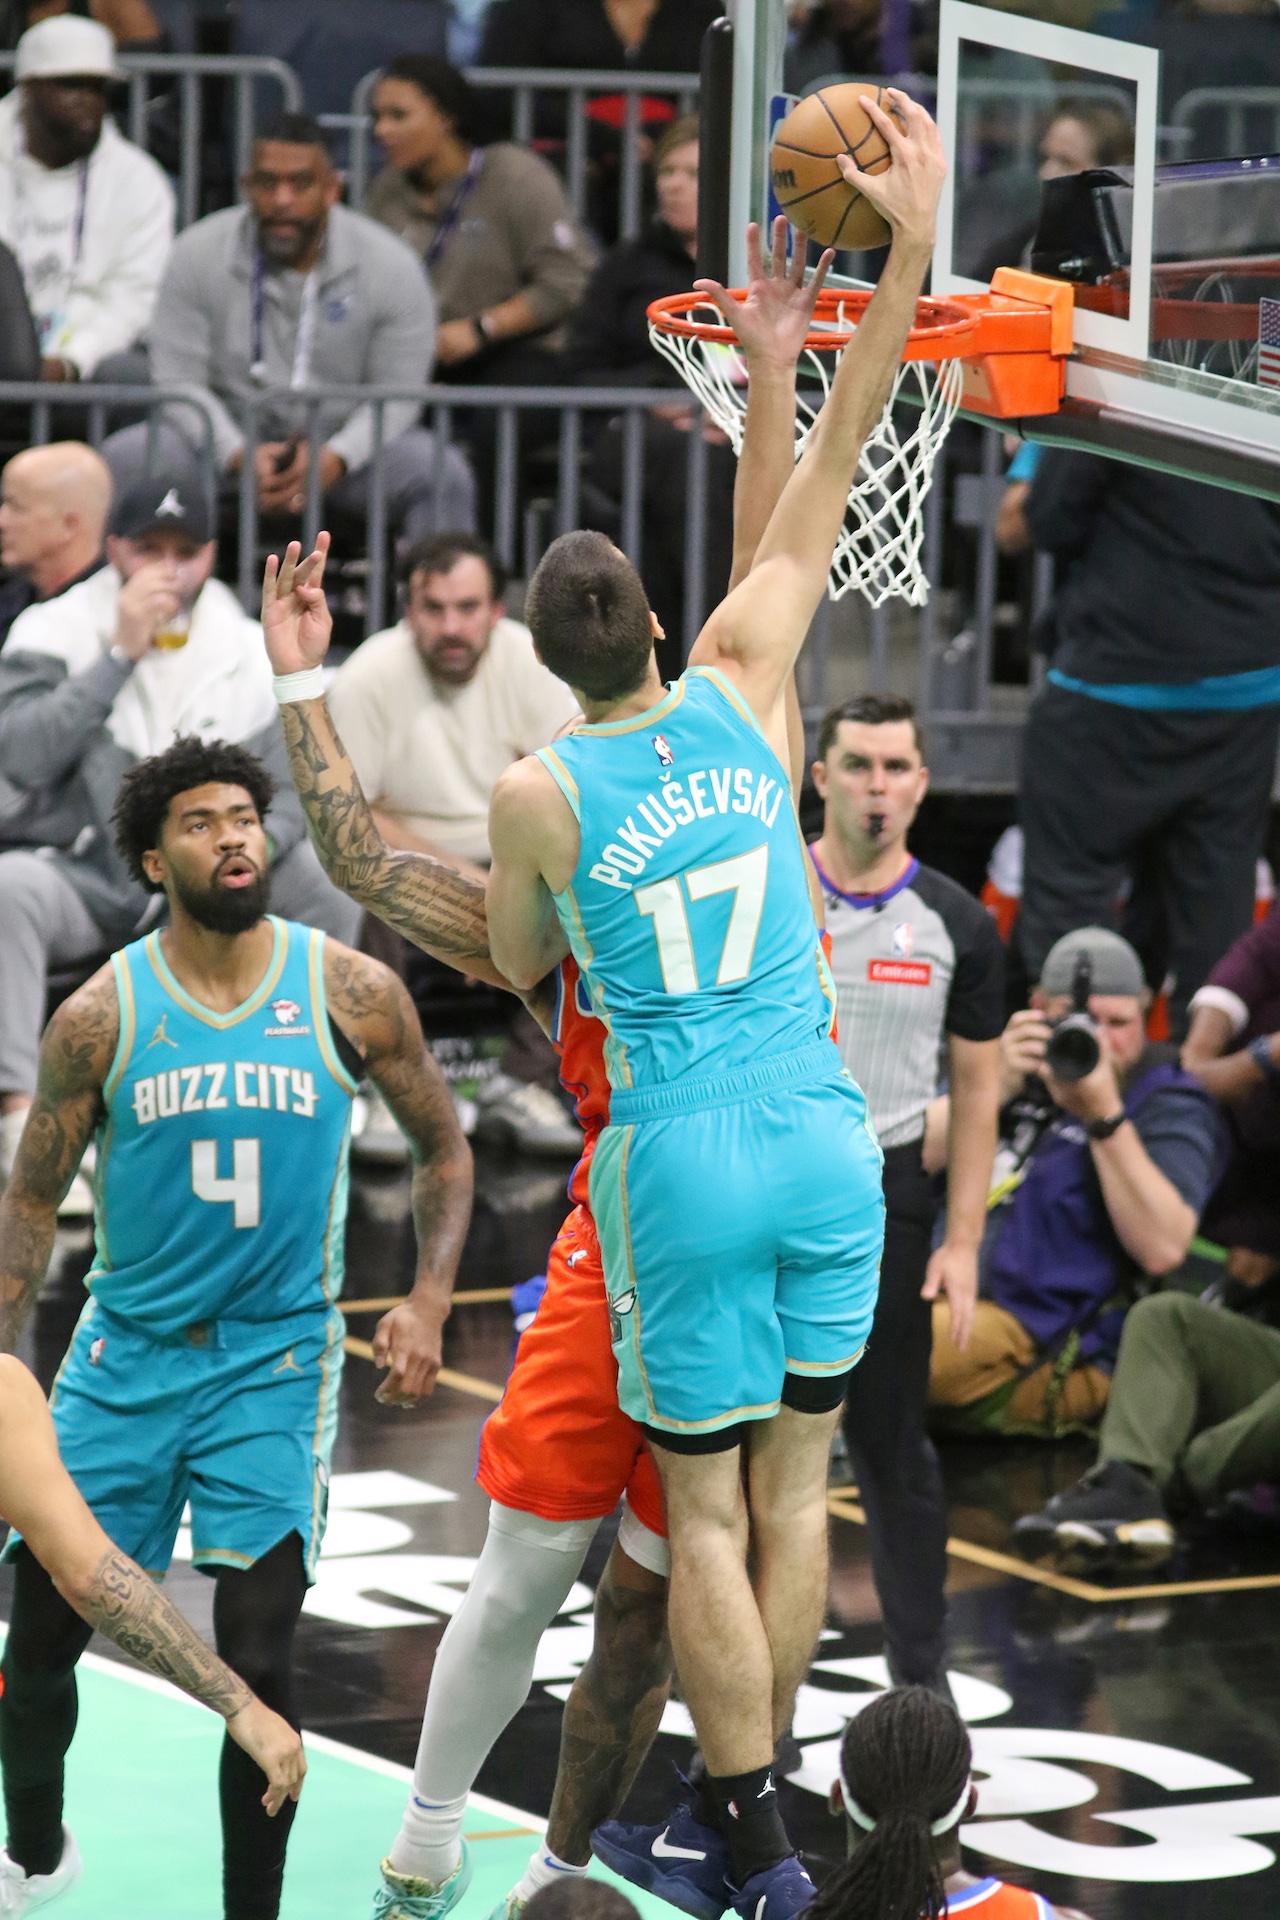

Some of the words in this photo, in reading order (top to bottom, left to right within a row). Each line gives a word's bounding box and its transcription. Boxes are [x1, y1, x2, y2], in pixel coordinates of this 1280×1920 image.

[588, 768, 783, 890] POKUŠEVSKI
[633, 842, 768, 994] 17
[132, 1062, 228, 1125] BUZZ
[234, 1061, 320, 1118] CITY
[191, 1138, 260, 1229] 4
